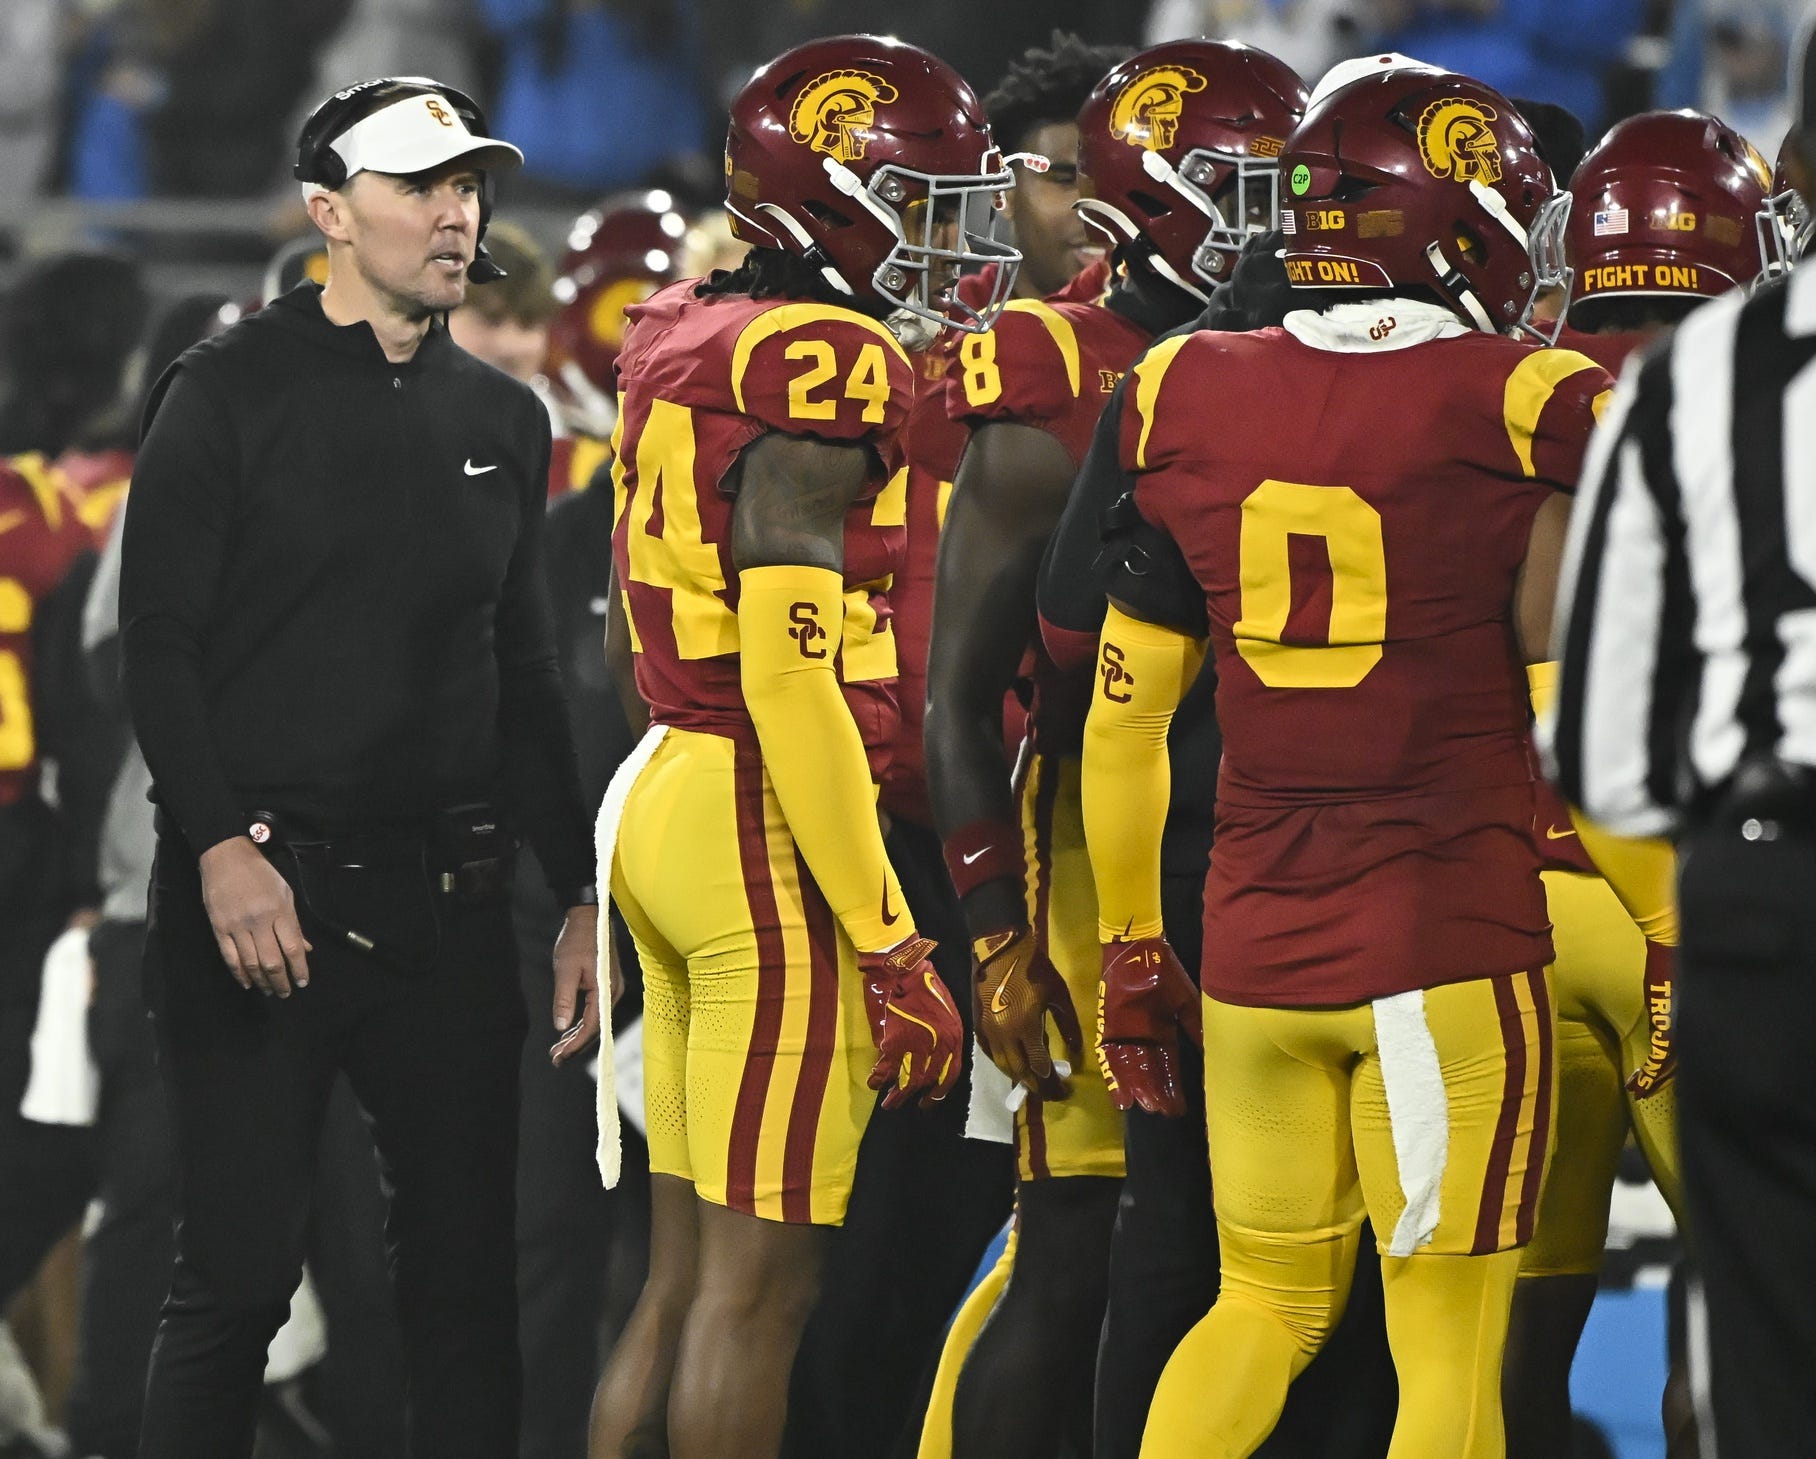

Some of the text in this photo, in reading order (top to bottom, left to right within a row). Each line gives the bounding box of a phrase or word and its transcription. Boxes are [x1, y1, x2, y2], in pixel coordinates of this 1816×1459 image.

[425, 100, 452, 127] SC
[1293, 173, 1309, 185] C2P
[1317, 261, 1360, 283] ON!
[1584, 265, 1698, 291] FIGHT ON!
[784, 339, 891, 425] 24
[960, 328, 1002, 407] 8
[1233, 479, 1388, 689] 0
[788, 602, 828, 660] SC
[1100, 641, 1135, 704] SC
[1637, 980, 1672, 1091] TROJANS
